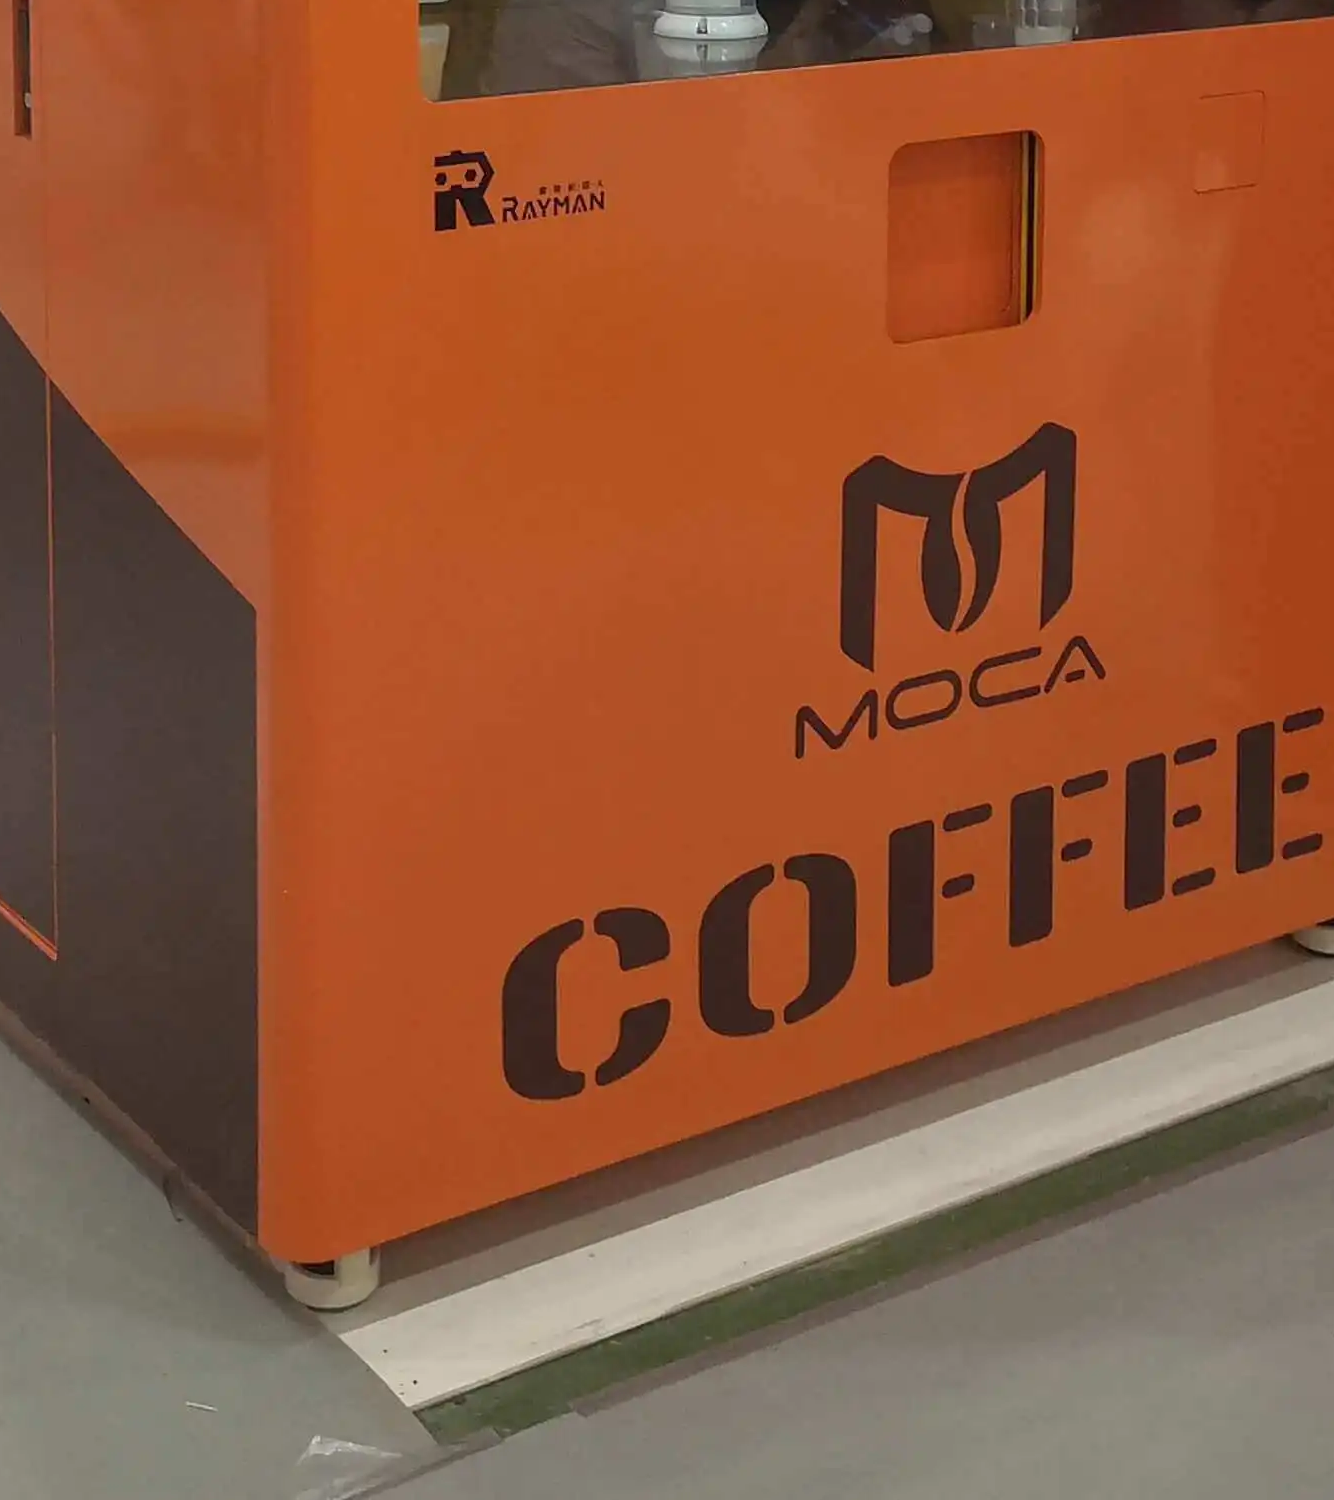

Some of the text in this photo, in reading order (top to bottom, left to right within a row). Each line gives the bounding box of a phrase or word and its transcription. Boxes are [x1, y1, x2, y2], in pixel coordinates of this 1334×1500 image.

[502, 191, 606, 223] RAYMAN
[794, 635, 1107, 760] MOCA
[501, 708, 1325, 1101] COFFEE
